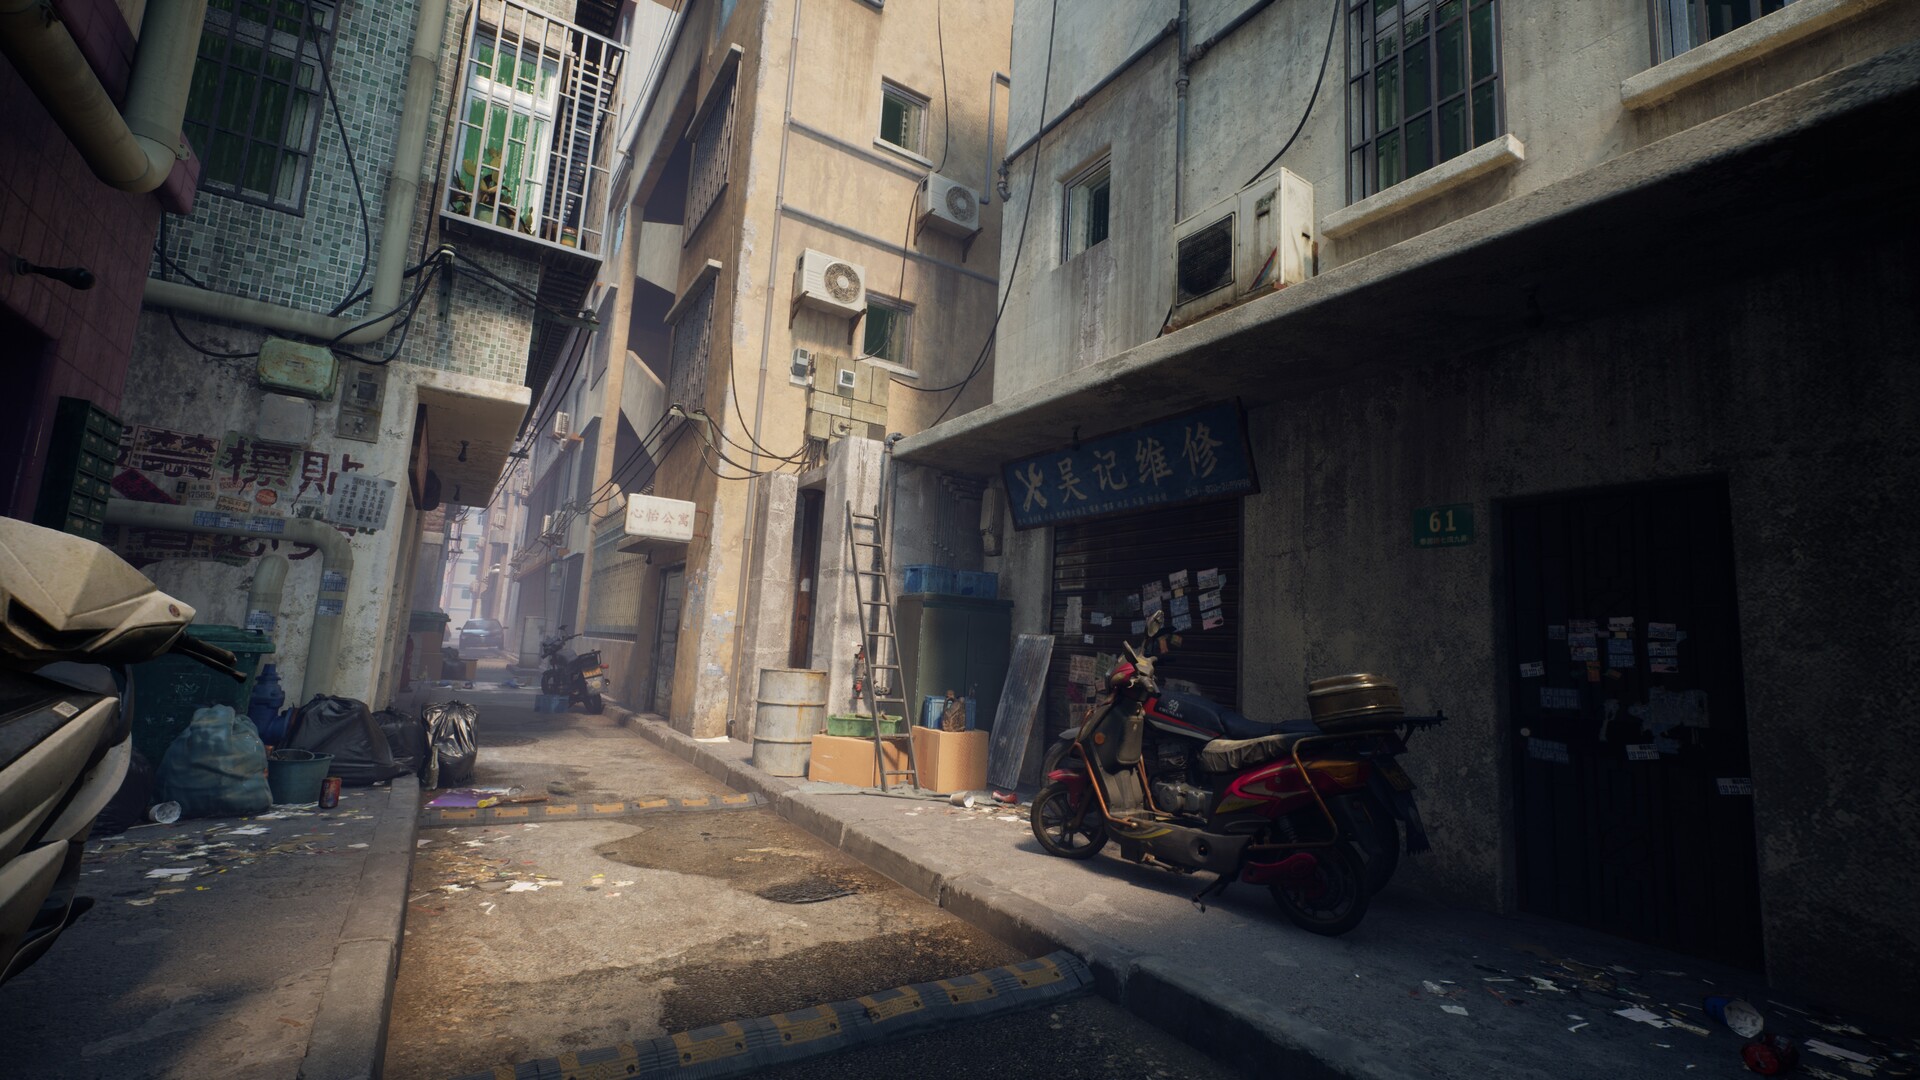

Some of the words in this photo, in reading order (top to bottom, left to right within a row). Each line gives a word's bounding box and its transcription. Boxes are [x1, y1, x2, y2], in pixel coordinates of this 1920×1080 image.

[1057, 422, 1223, 504] 吴记维修
[630, 508, 690, 528] 心怡公寓
[1429, 509, 1457, 533] 61
